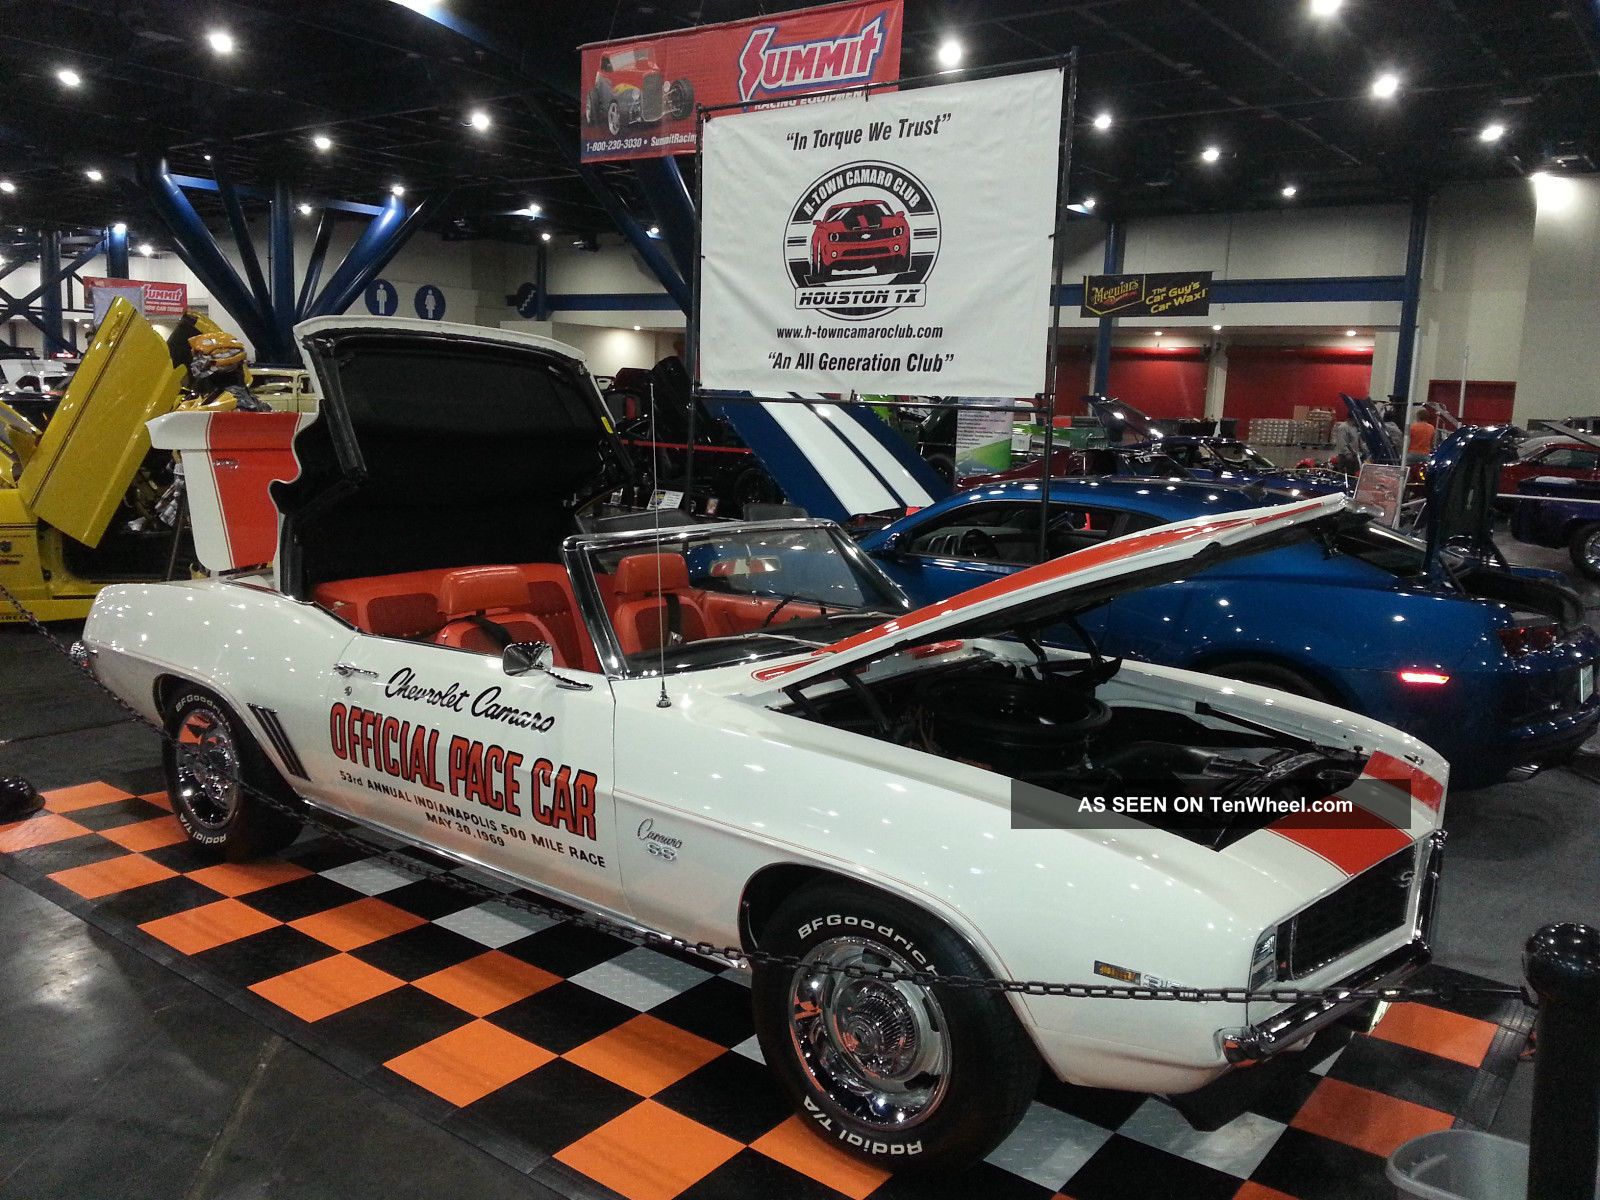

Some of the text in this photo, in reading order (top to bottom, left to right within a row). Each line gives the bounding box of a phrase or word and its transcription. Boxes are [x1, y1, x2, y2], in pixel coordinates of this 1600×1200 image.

[585, 137, 642, 152] 1-800-230-3030
[813, 126, 863, 149] Torque
[868, 121, 893, 142] We
[803, 168, 921, 216] H-TOWN CAMARO CLUB
[798, 288, 922, 306] HOUSTON TX
[1145, 281, 1200, 306] Car Guy's
[1152, 286, 1167, 295] The
[1150, 301, 1173, 314] Car
[776, 324, 944, 339] www.h-towncamaroclub.com
[795, 352, 815, 370] All
[818, 353, 901, 372] Generation
[384, 667, 555, 734] Chevrolet Camaro
[329, 701, 598, 841] OFFICIAL PACE CAR
[339, 769, 606, 869] 53rd ANNUAL INDIANAPOLIS 500 MILE RACE
[425, 811, 452, 830] MAY
[192, 830, 228, 845] Radial
[637, 817, 684, 849] Camaro
[646, 841, 679, 862] SS
[839, 1129, 923, 1156] Radial
